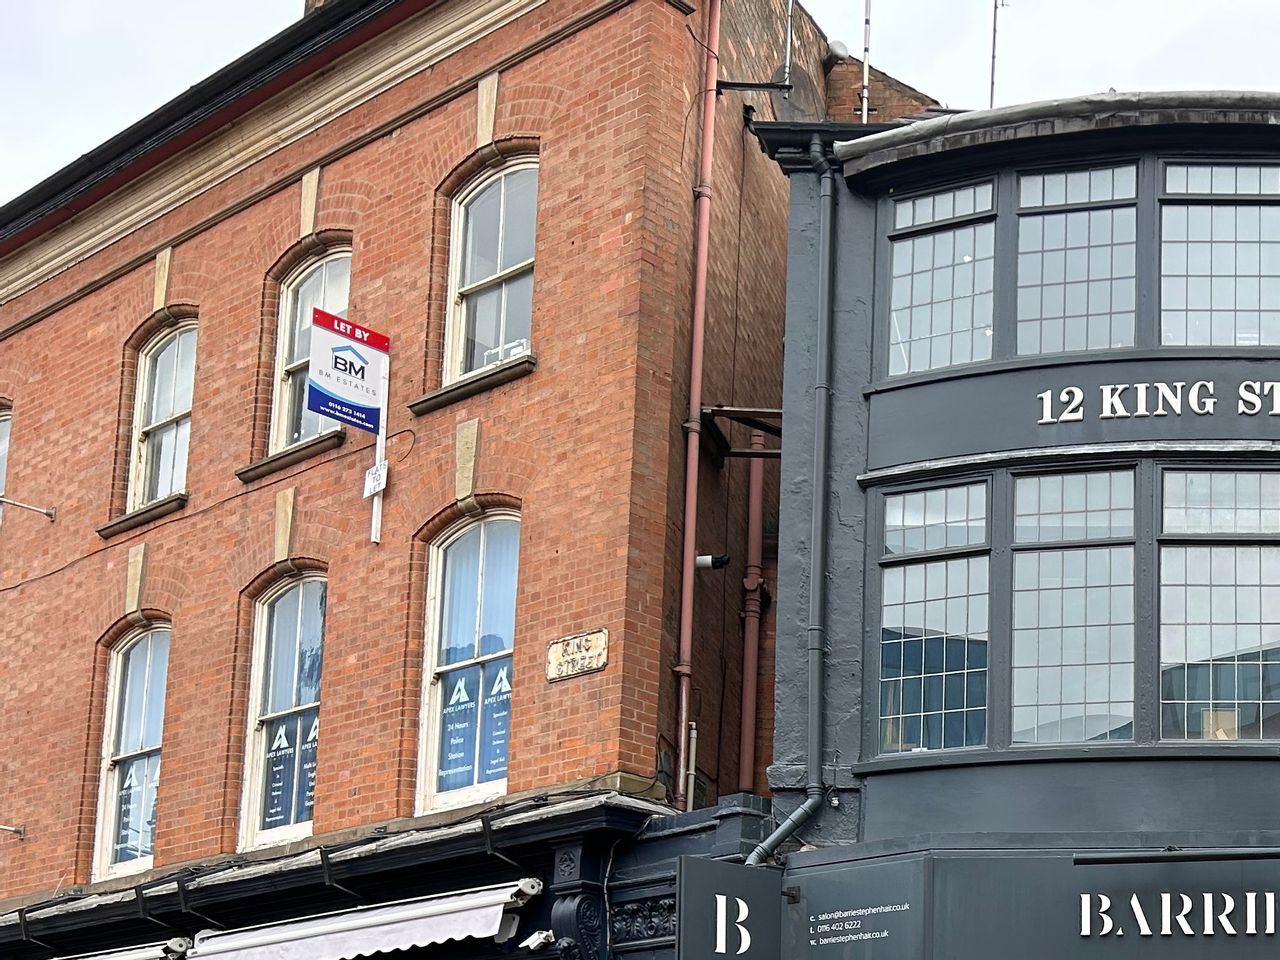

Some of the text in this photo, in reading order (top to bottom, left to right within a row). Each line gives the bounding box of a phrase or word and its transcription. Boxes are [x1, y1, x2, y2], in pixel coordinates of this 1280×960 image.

[334, 320, 370, 341] LET BY
[334, 355, 366, 380] BM
[319, 370, 377, 396] BM ESTATES
[1037, 386, 1085, 424] 12
[1099, 381, 1218, 419] KING
[367, 462, 387, 478] FLATS
[373, 474, 382, 484] TO
[369, 482, 382, 494] LET
[562, 638, 592, 657] KING
[557, 652, 602, 676] STREET
[443, 701, 476, 714] APEX LAWYERS
[484, 695, 496, 704] APEX
[455, 721, 469, 730] Hours
[450, 737, 464, 745] Police
[447, 752, 465, 760] Station
[818, 902, 910, 921] salon@barriestephenhair.co.uk
[714, 894, 752, 955] B
[831, 922, 844, 931] 402
[844, 920, 861, 929] 6222
[819, 929, 889, 945] barriestephenhair.co.uk
